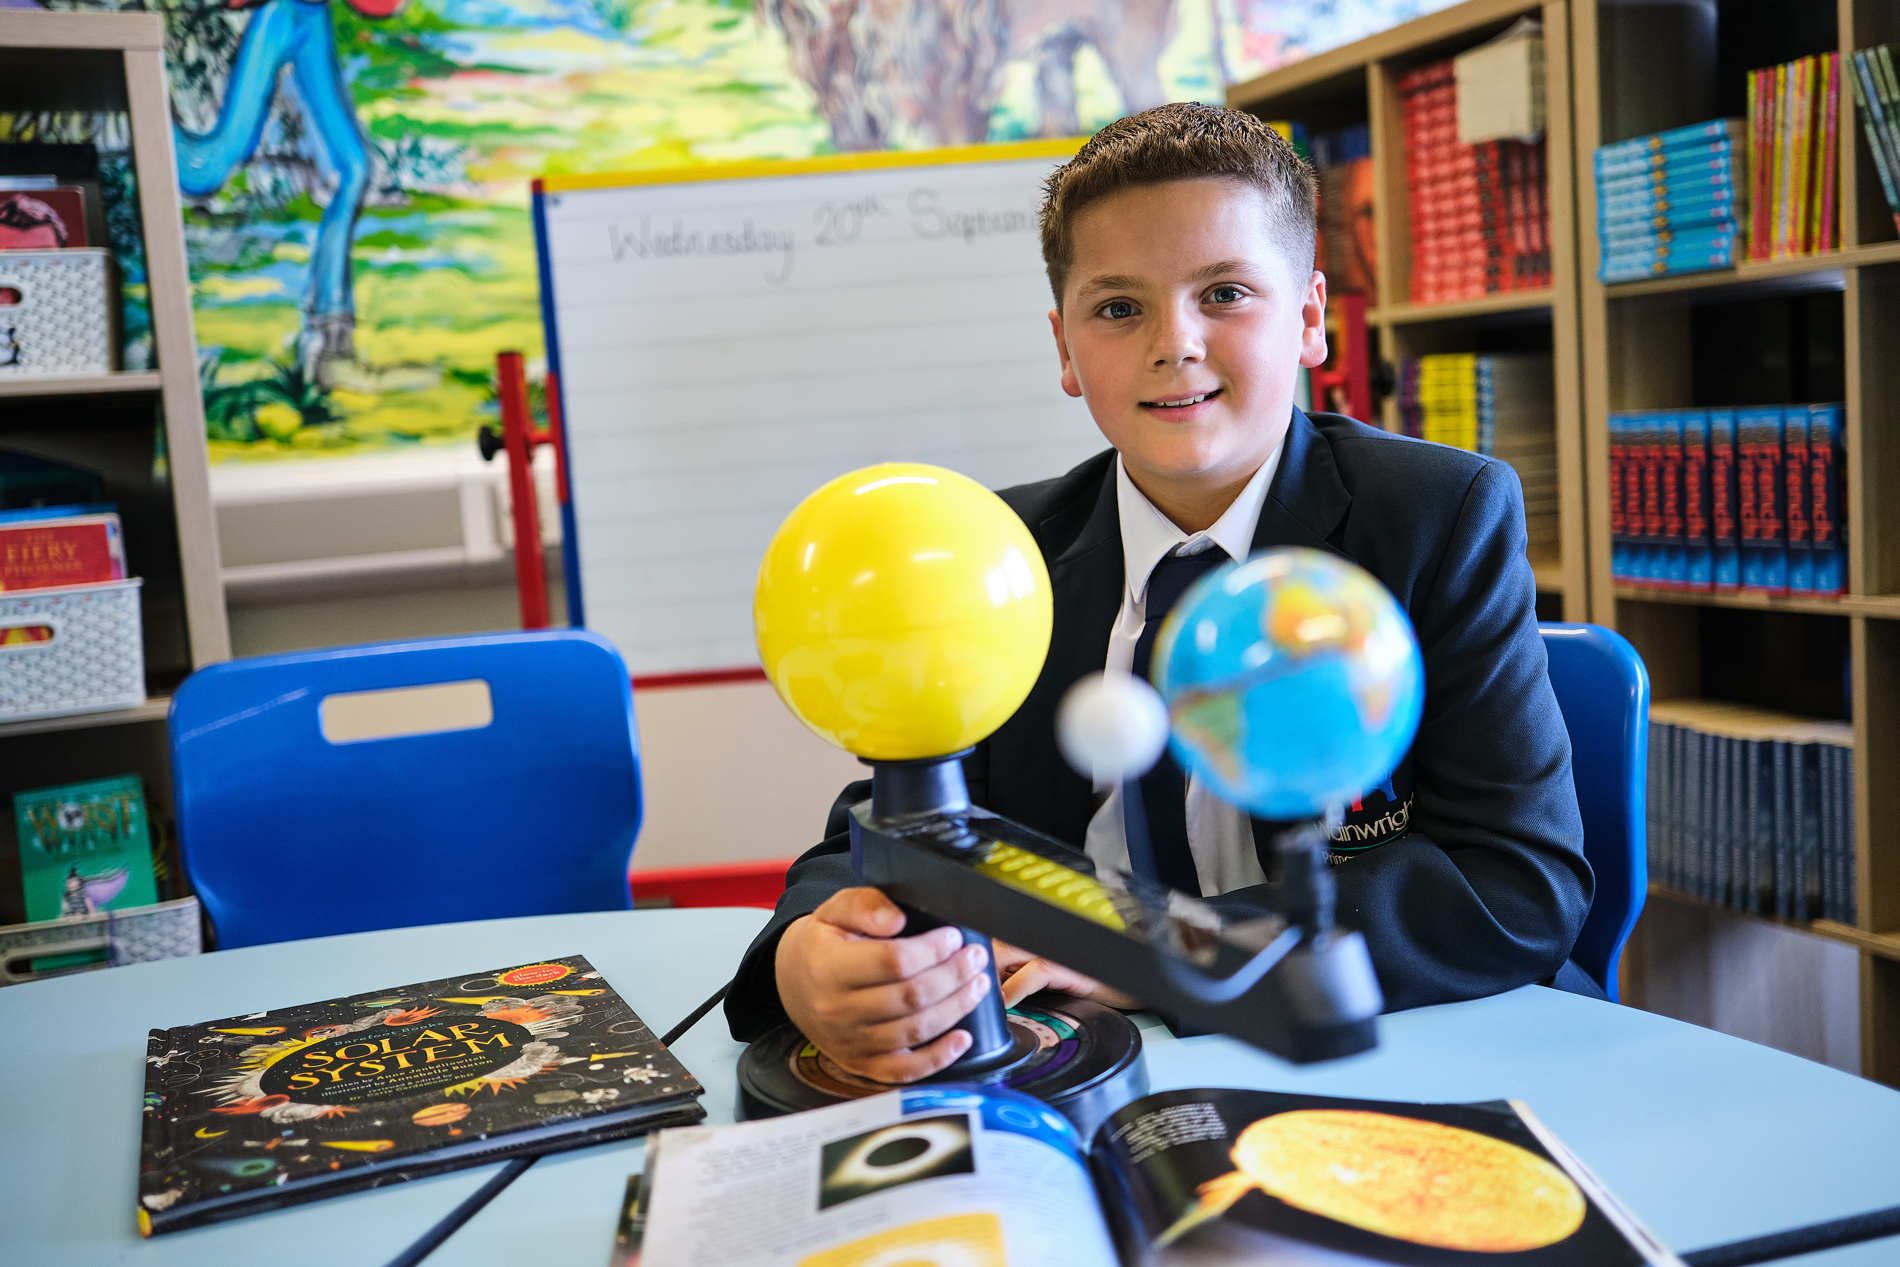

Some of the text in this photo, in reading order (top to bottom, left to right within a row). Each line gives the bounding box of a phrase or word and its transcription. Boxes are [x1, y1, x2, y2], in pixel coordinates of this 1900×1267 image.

[607, 213, 797, 287] Wednesday
[1786, 443, 1808, 541] French
[1812, 443, 1832, 542] French
[6, 541, 77, 562] FIERY
[288, 1032, 513, 1090] SYSTEM
[302, 1022, 489, 1068] SOLAR
[333, 1022, 444, 1046] Barefoot Books
